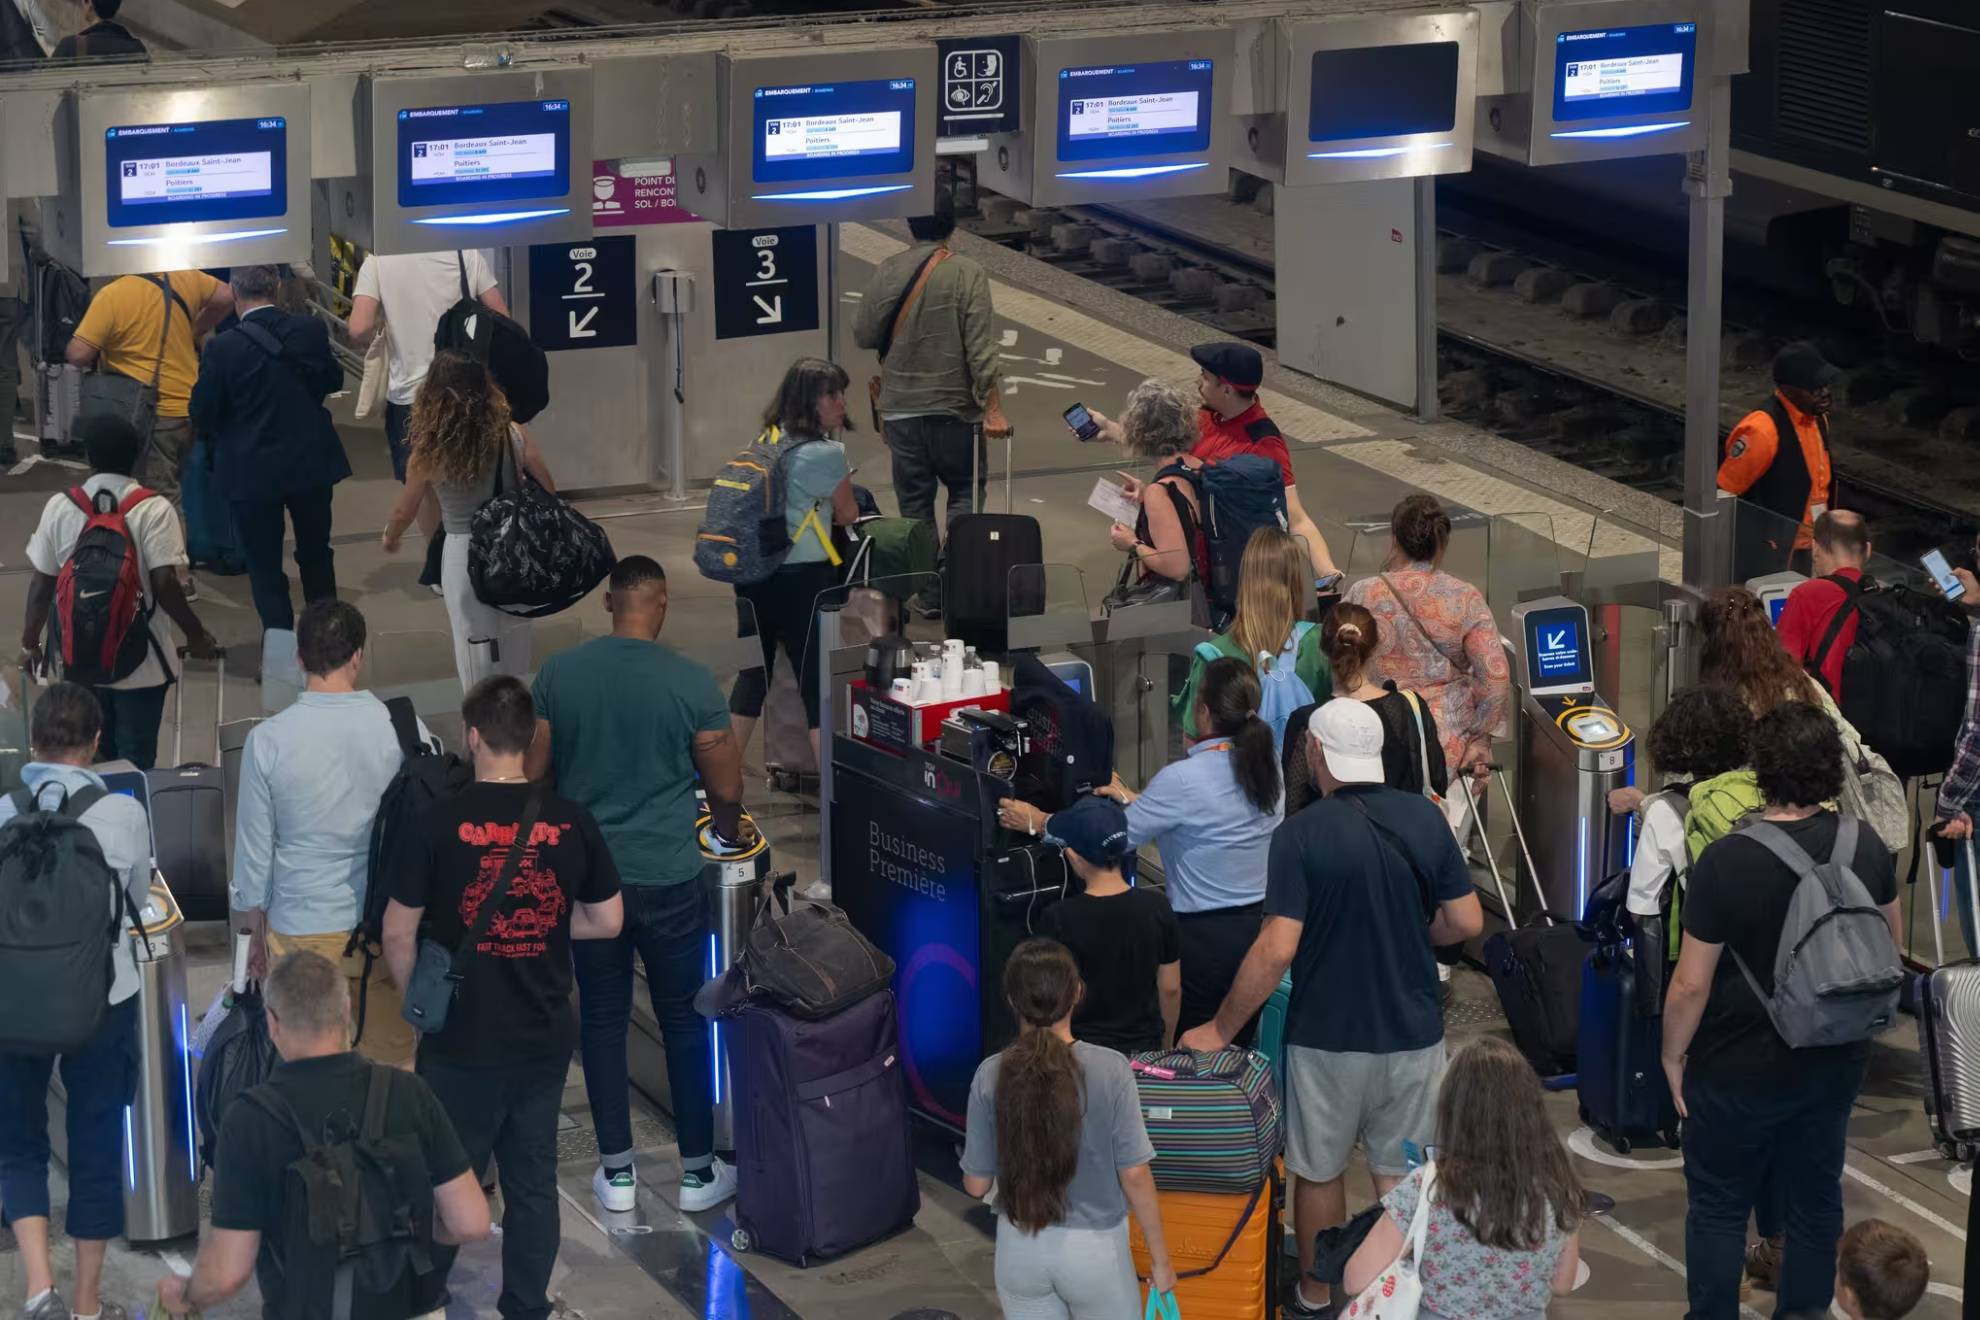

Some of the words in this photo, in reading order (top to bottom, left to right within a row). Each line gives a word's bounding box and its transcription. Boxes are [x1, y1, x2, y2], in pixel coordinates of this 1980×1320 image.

[765, 88, 811, 96] EMBARQUEMENT
[410, 109, 458, 118] EMBARQUEMENT
[118, 127, 170, 136] EMBARQUEMENT
[635, 177, 662, 185] POINT
[635, 200, 652, 208] SOL
[654, 200, 658, 208] /
[755, 236, 775, 246] Voie
[572, 250, 592, 258] Voie
[756, 250, 776, 280] 3
[574, 262, 593, 292] 2
[1609, 756, 1615, 765] 8
[869, 820, 945, 874] Business
[738, 868, 745, 877] 5
[870, 848, 946, 902] Première
[150, 942, 156, 952] 3
